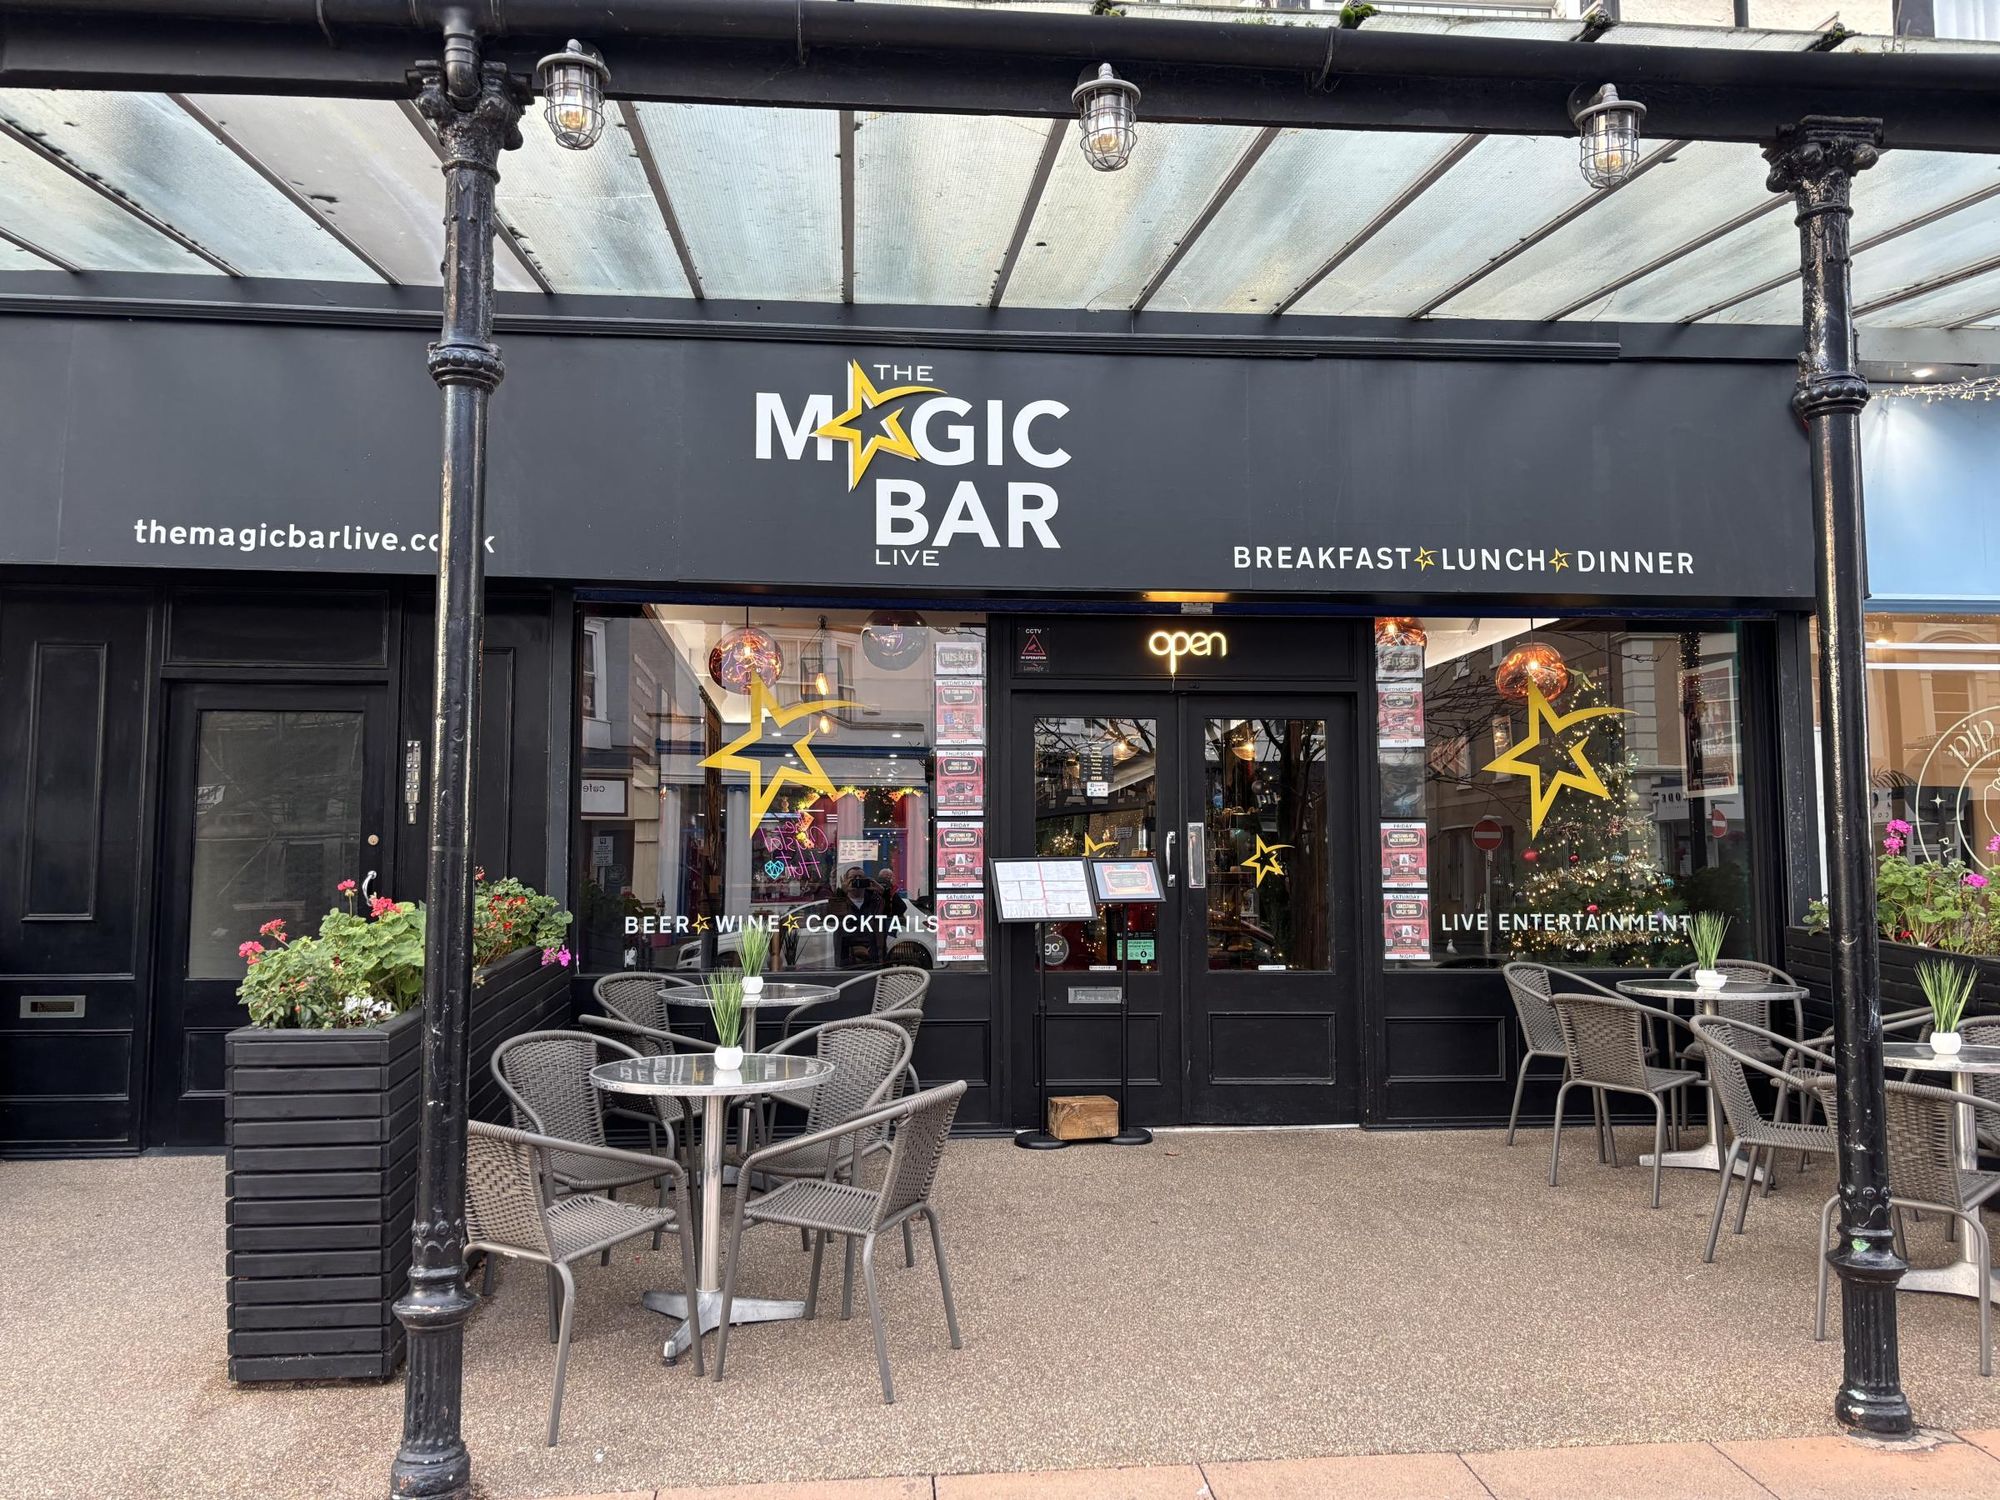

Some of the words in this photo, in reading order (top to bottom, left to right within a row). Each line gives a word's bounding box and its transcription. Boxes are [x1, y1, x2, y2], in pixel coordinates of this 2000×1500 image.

[873, 364, 934, 381] THE
[875, 478, 1062, 549] BAR
[134, 519, 495, 554] themagicbarlive.cok
[875, 549, 940, 566] LIVE
[1233, 546, 1412, 570] BREAKFAST
[1442, 547, 1546, 572] LUNCH
[1577, 549, 1695, 575] DINNER
[1149, 631, 1227, 674] open
[624, 915, 690, 934] BEER
[715, 914, 780, 934] WINE
[806, 913, 939, 934] COCKTAILS
[1441, 913, 1489, 931] LIVE
[1498, 913, 1690, 932] ENTERTAINMENT
